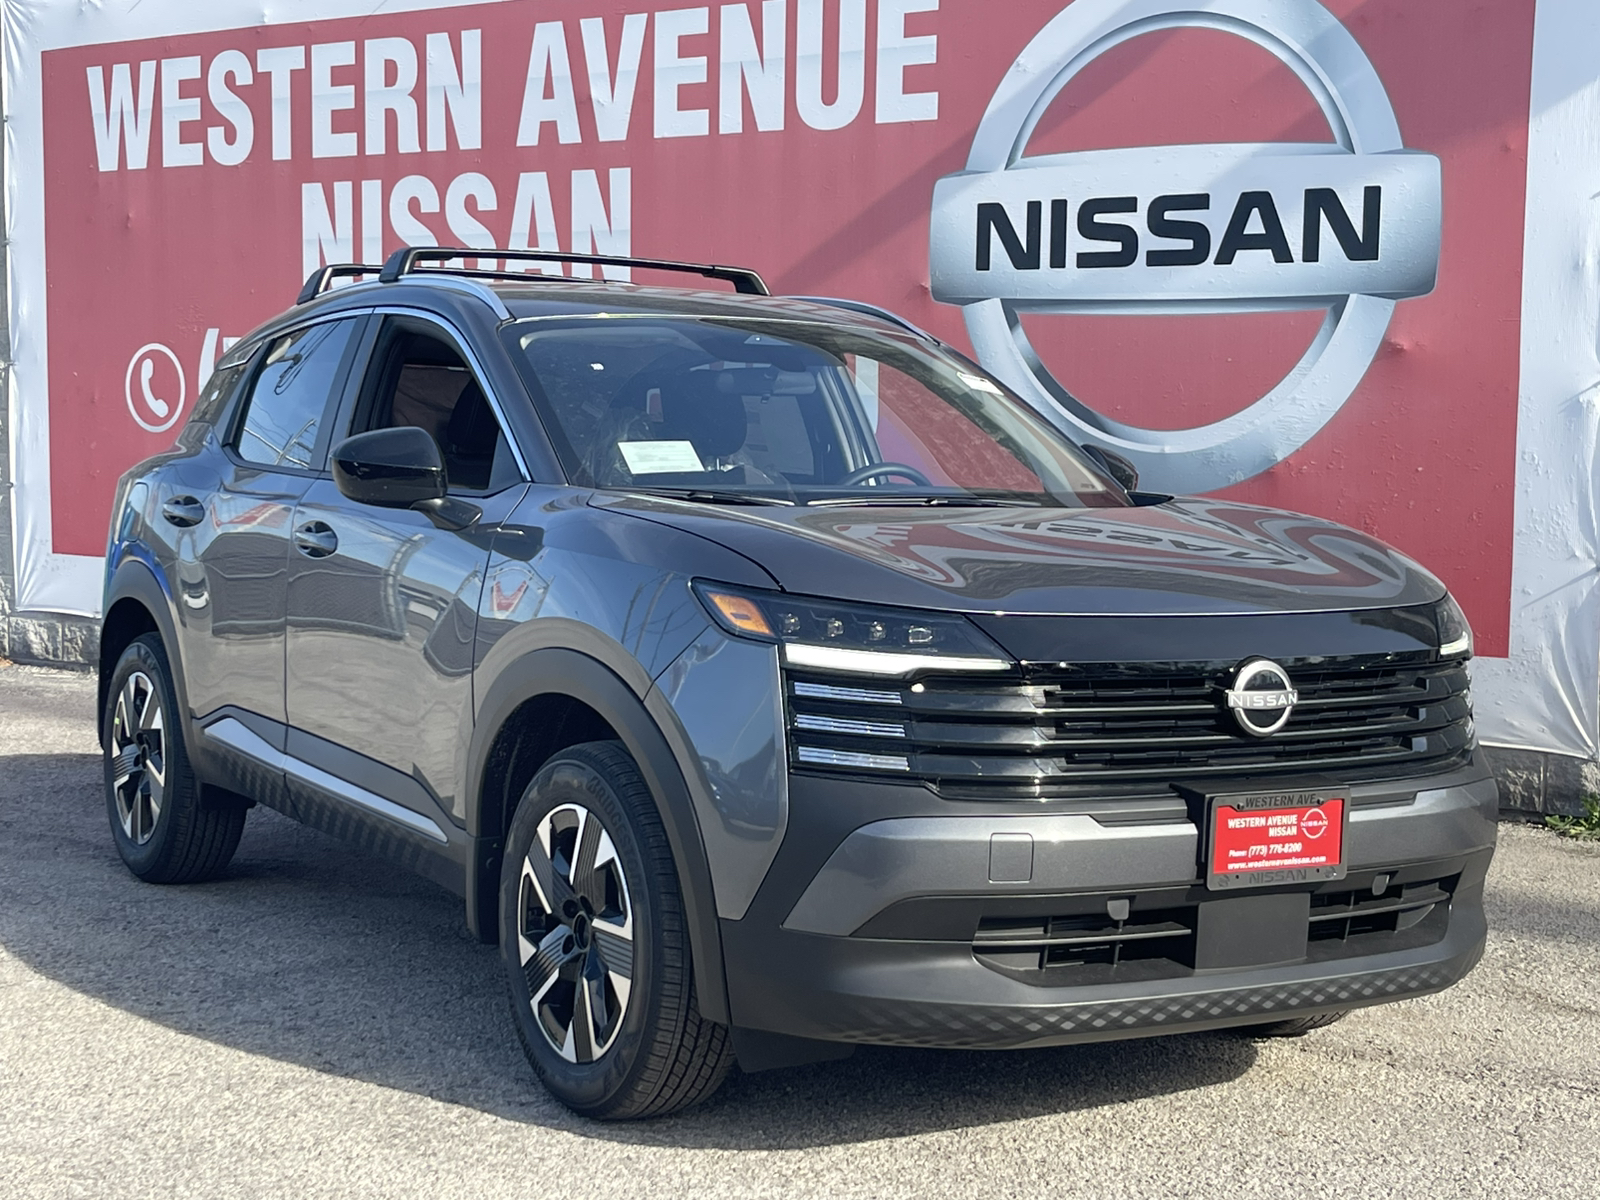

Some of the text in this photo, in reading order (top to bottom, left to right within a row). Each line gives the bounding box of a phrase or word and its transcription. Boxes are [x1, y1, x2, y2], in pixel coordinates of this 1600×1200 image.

[86, 0, 940, 173] WESTERN AVENUE
[301, 167, 632, 286] NISSAN
[976, 185, 1382, 271] NISSAN
[1230, 692, 1297, 707] NISSAN
[1245, 793, 1317, 808] WESTERN AVE
[1227, 814, 1298, 829] WESTERN AVENUE
[1300, 819, 1329, 827] NISSAN
[1268, 825, 1298, 837] NISSAN
[586, 775, 645, 903] BRIDGESTONE
[1248, 844, 1268, 858] (773)
[1249, 868, 1307, 884] NISSAN
